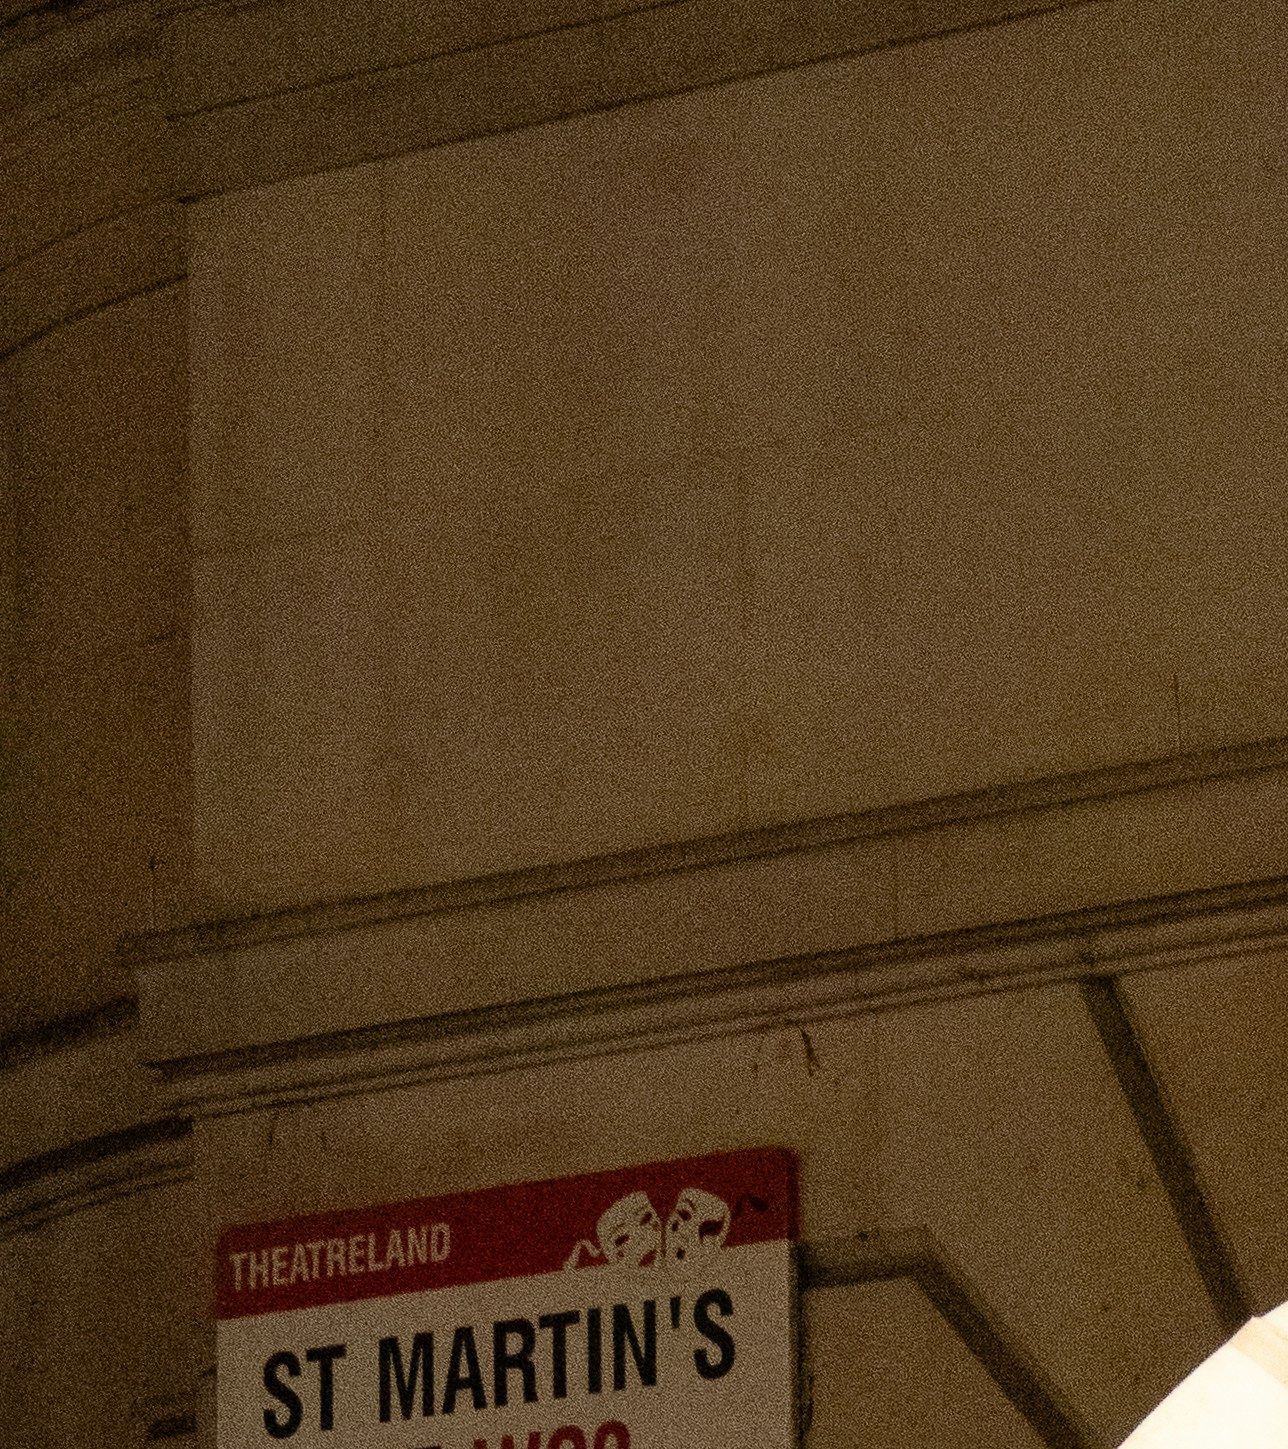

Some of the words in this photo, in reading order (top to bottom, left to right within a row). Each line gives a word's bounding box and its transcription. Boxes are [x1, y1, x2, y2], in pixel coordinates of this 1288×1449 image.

[229, 1222, 452, 1292] THEATRELAND
[261, 1344, 347, 1439] ST
[377, 1288, 737, 1424] MARTIN'S
